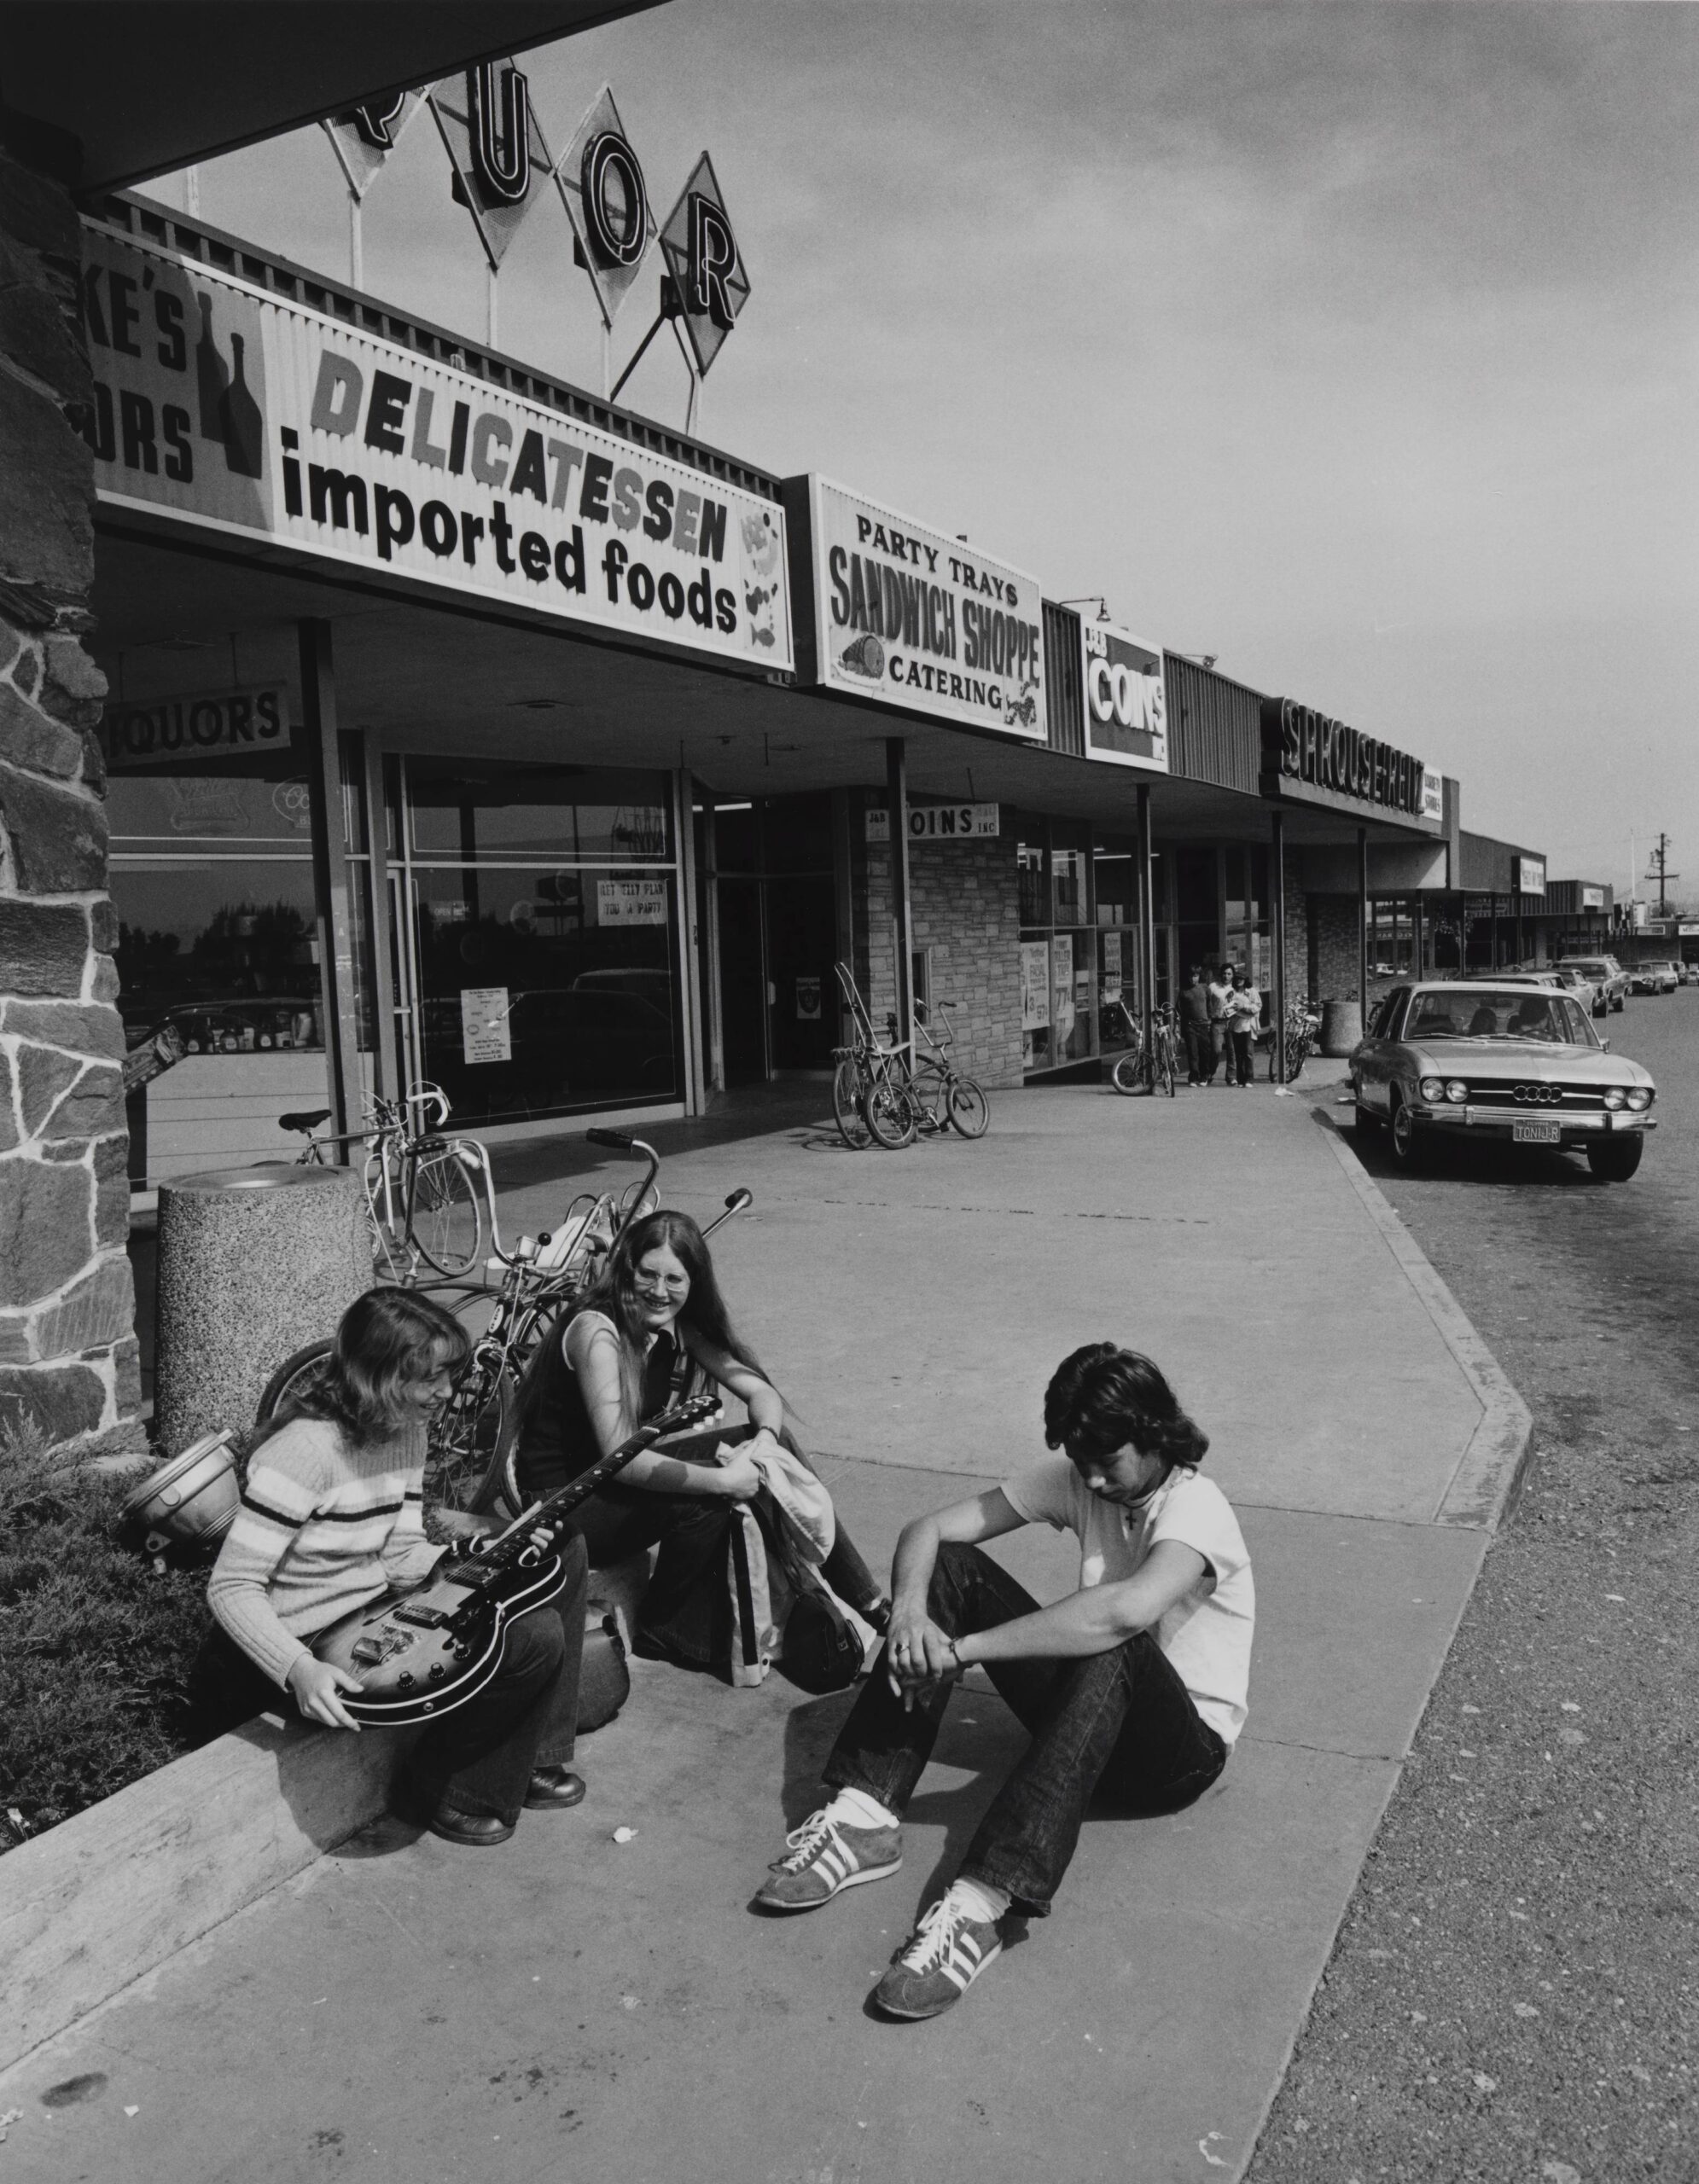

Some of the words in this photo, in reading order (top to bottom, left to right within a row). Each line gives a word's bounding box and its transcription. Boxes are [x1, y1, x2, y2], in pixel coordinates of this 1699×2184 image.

[310, 348, 728, 563] DELICATESSEN
[281, 426, 588, 595] imported
[602, 538, 738, 635] foods
[855, 514, 940, 572] PARTY
[948, 555, 1018, 607] TRAYS
[829, 545, 957, 660] SANDWICH
[962, 598, 1041, 684] SHOPPE
[888, 655, 1003, 711] CATERING
[1088, 658, 1164, 735] COINS
[869, 812, 886, 823] J&B
[910, 809, 973, 835] OINS
[978, 822, 995, 834] INC
[627, 903, 634, 915] A
[637, 902, 661, 915] PARTY
[643, 883, 664, 896] PLAN
